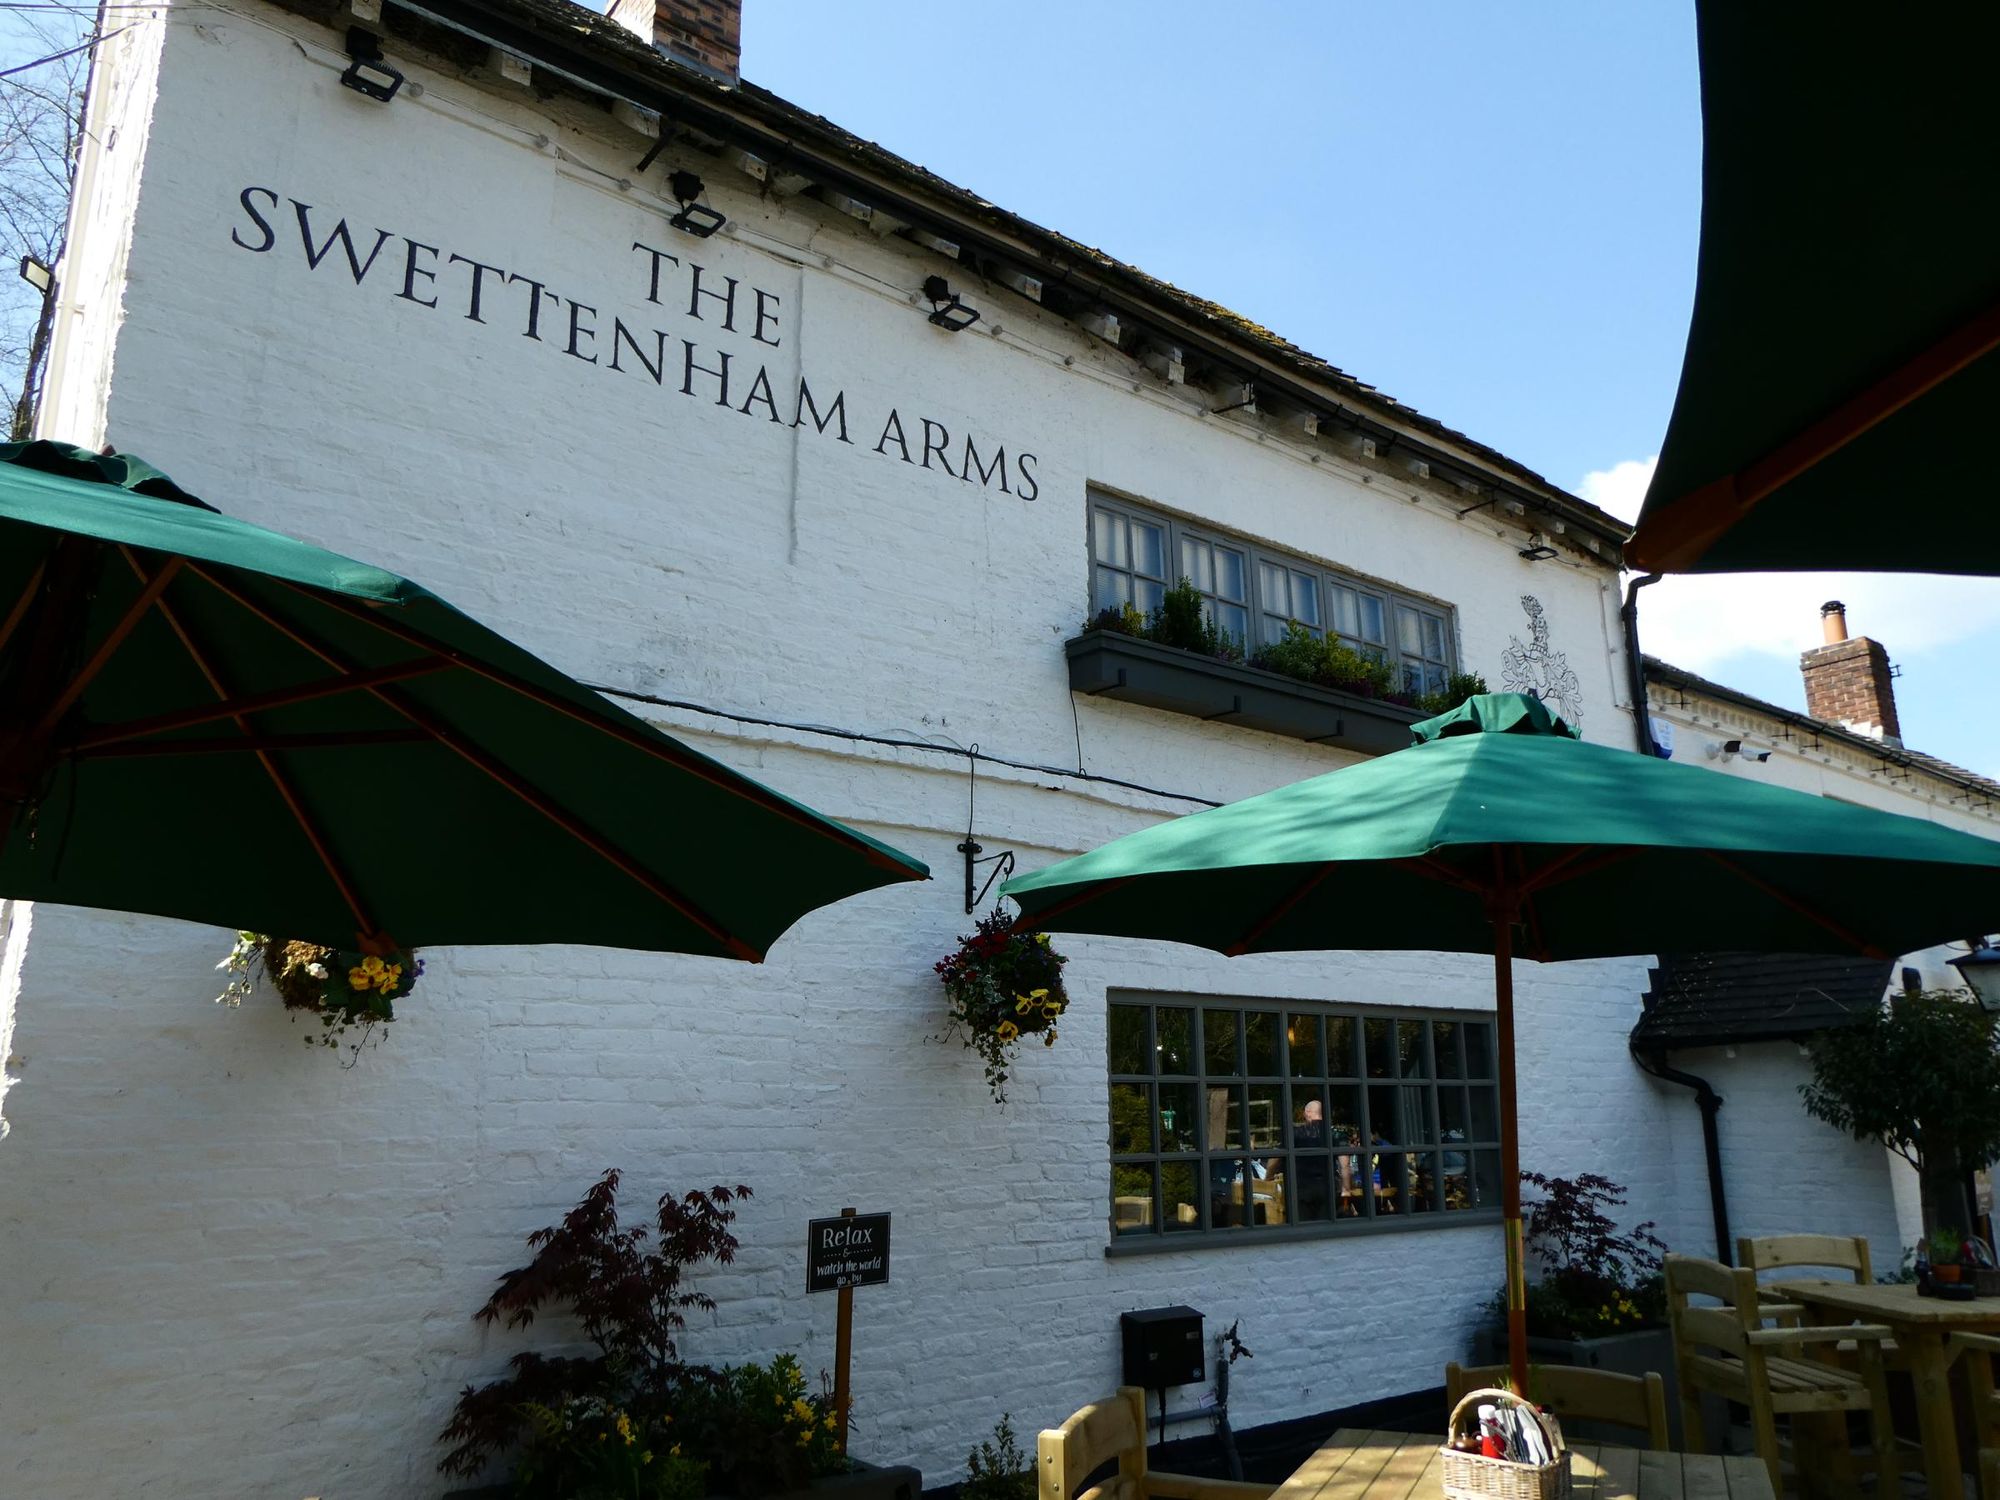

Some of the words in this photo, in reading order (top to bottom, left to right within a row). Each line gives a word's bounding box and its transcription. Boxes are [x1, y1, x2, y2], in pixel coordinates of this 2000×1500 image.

[632, 242, 780, 348] THE
[232, 186, 855, 445] SWETTENHAM
[872, 408, 1039, 501] ARMS
[823, 1226, 872, 1248] Relax
[842, 1248, 851, 1258] &
[817, 1261, 843, 1276] watch
[845, 1260, 858, 1272] the
[859, 1256, 881, 1270] world
[837, 1276, 846, 1287] go
[852, 1273, 862, 1284] by
